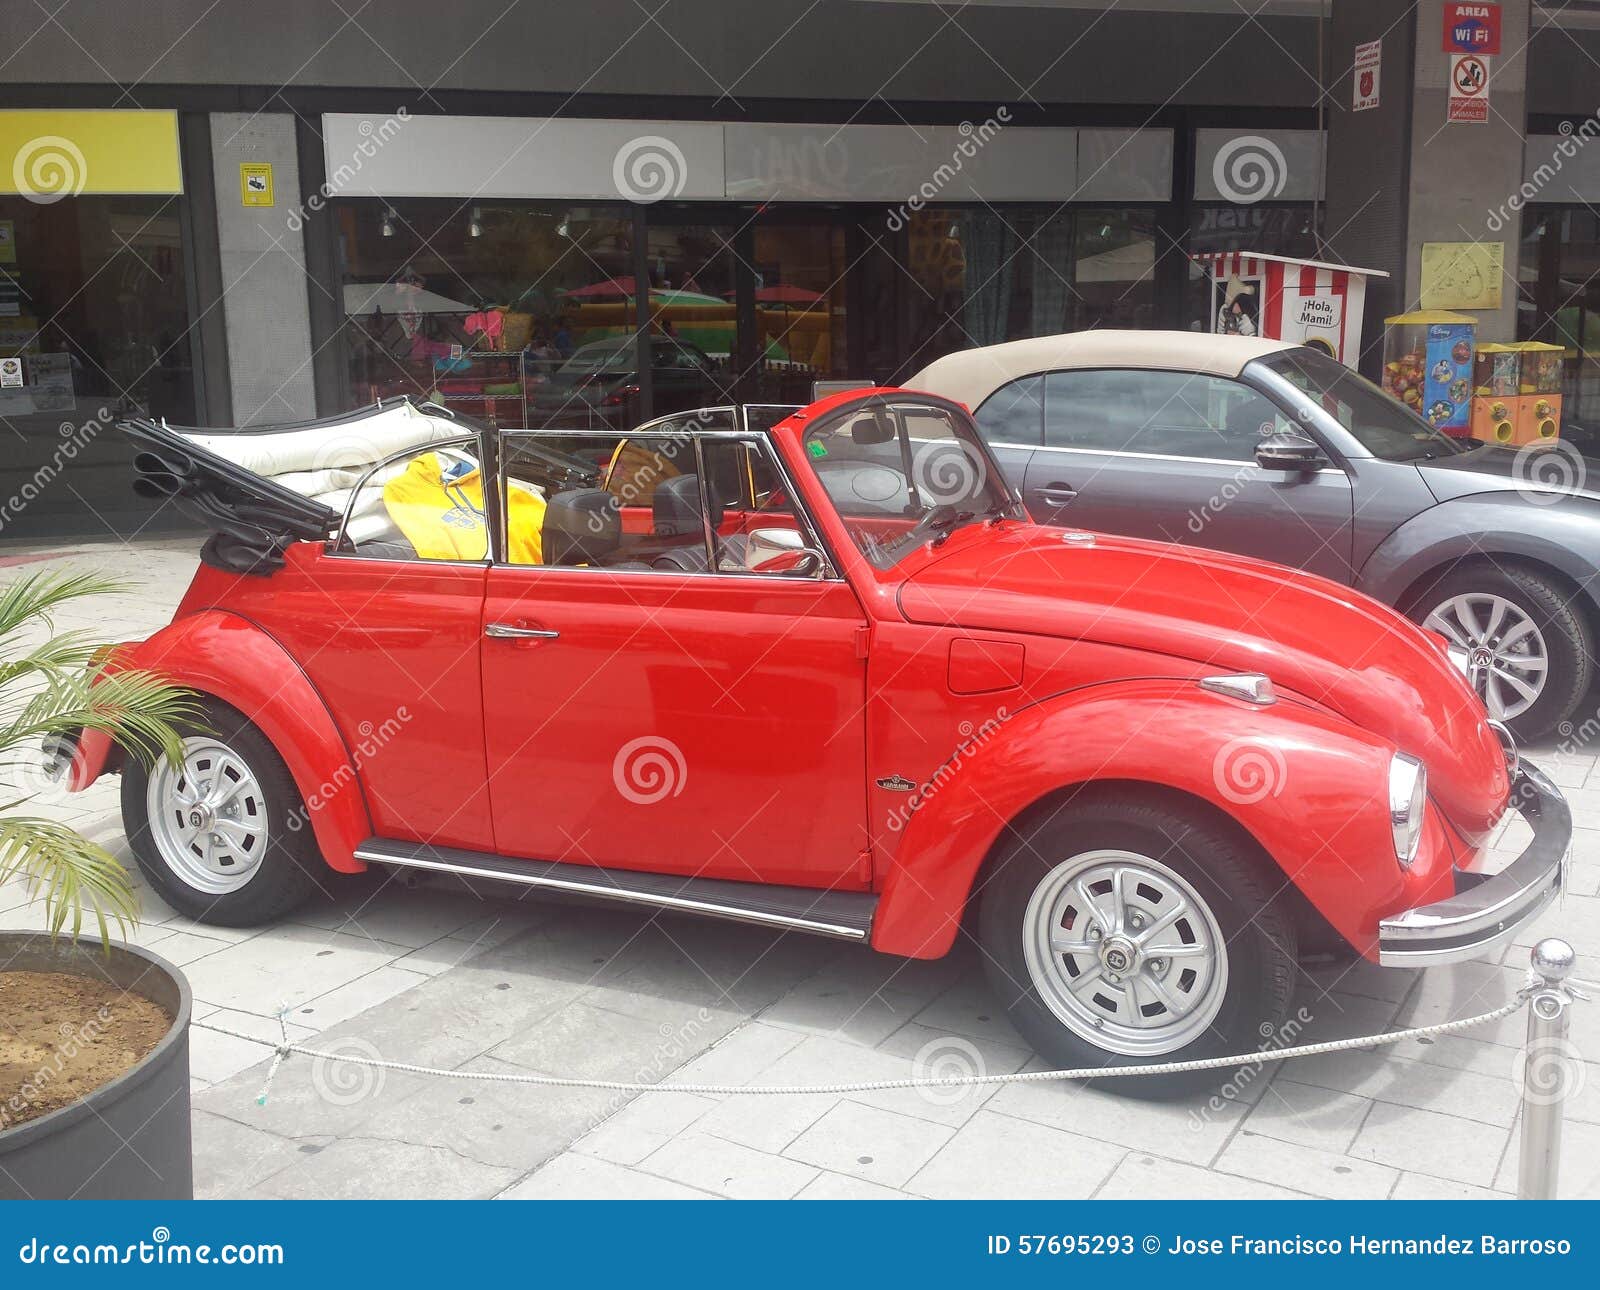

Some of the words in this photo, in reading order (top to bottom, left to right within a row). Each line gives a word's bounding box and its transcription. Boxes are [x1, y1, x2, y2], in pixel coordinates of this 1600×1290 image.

[1455, 6, 1489, 17] AREA
[1455, 28, 1471, 41] Wi
[1475, 29, 1489, 42] Fi
[1304, 300, 1333, 314] ¡Hola,
[1300, 312, 1333, 325] Mami!
